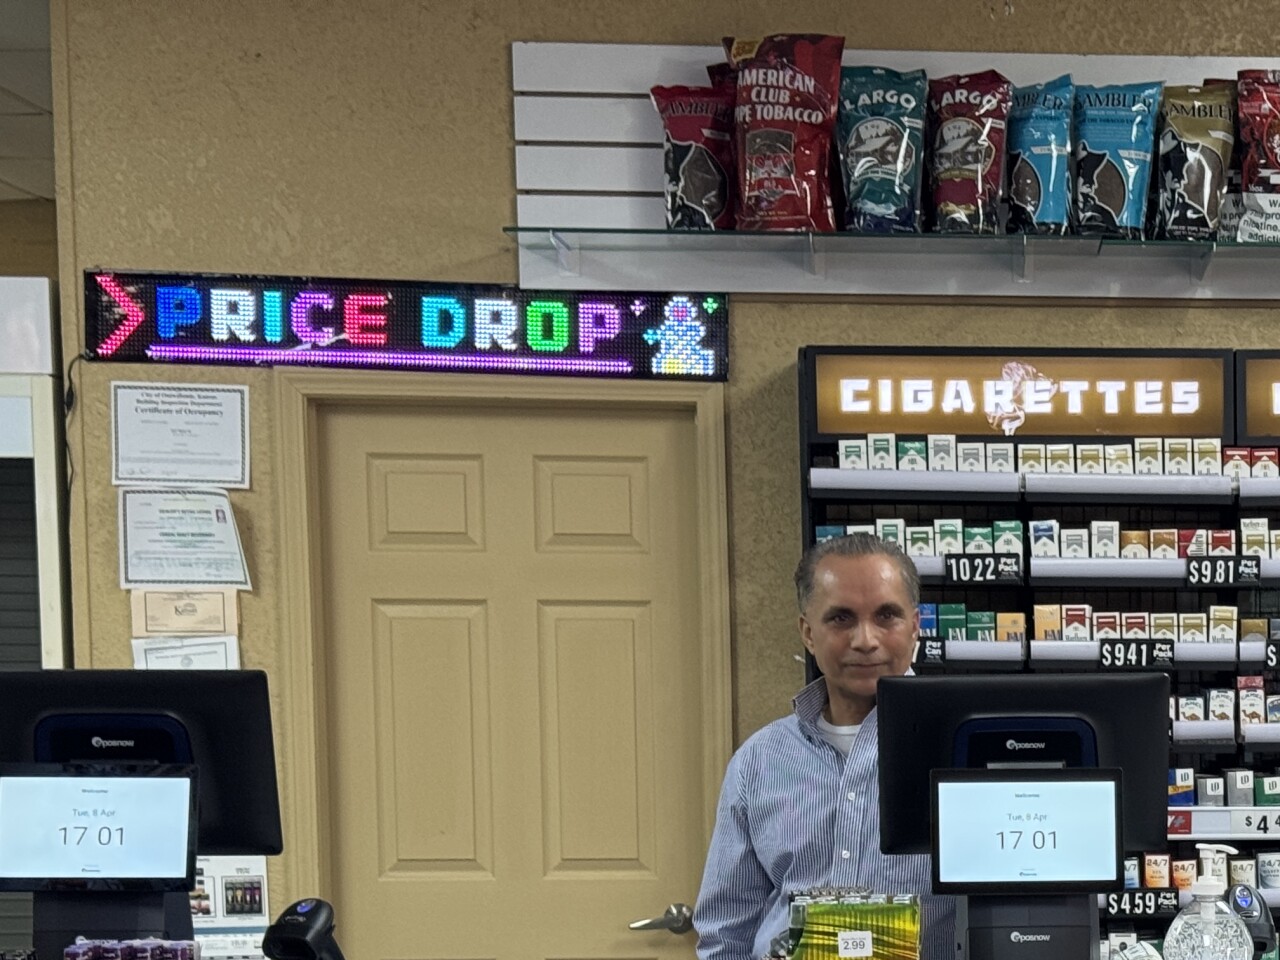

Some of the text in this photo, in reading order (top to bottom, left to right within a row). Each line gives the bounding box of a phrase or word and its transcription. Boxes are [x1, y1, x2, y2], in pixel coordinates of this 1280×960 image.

[737, 69, 815, 94] AMERICAN
[751, 87, 790, 103] CLUB
[844, 90, 916, 110] LARGO
[757, 105, 823, 124] TOBACCO
[156, 286, 622, 354] PRICE DROP
[839, 377, 1201, 416] CIGARETTES
[135, 407, 173, 415] Certificate
[184, 408, 223, 417] Occupancy
[999, 563, 1018, 572] Pack
[1189, 555, 1234, 578] $9.81
[925, 647, 942, 656] Can
[1102, 643, 1147, 666] $9.41
[1211, 694, 1233, 703] CAMEL
[1007, 813, 1047, 823] Tue, 8 Apr
[996, 831, 1058, 850] 17 01
[1146, 858, 1168, 867] 24/7
[1173, 864, 1195, 872] 24/7
[1232, 863, 1254, 871] 24/7
[1108, 892, 1155, 914] $4.59
[843, 940, 865, 950] 2.99
